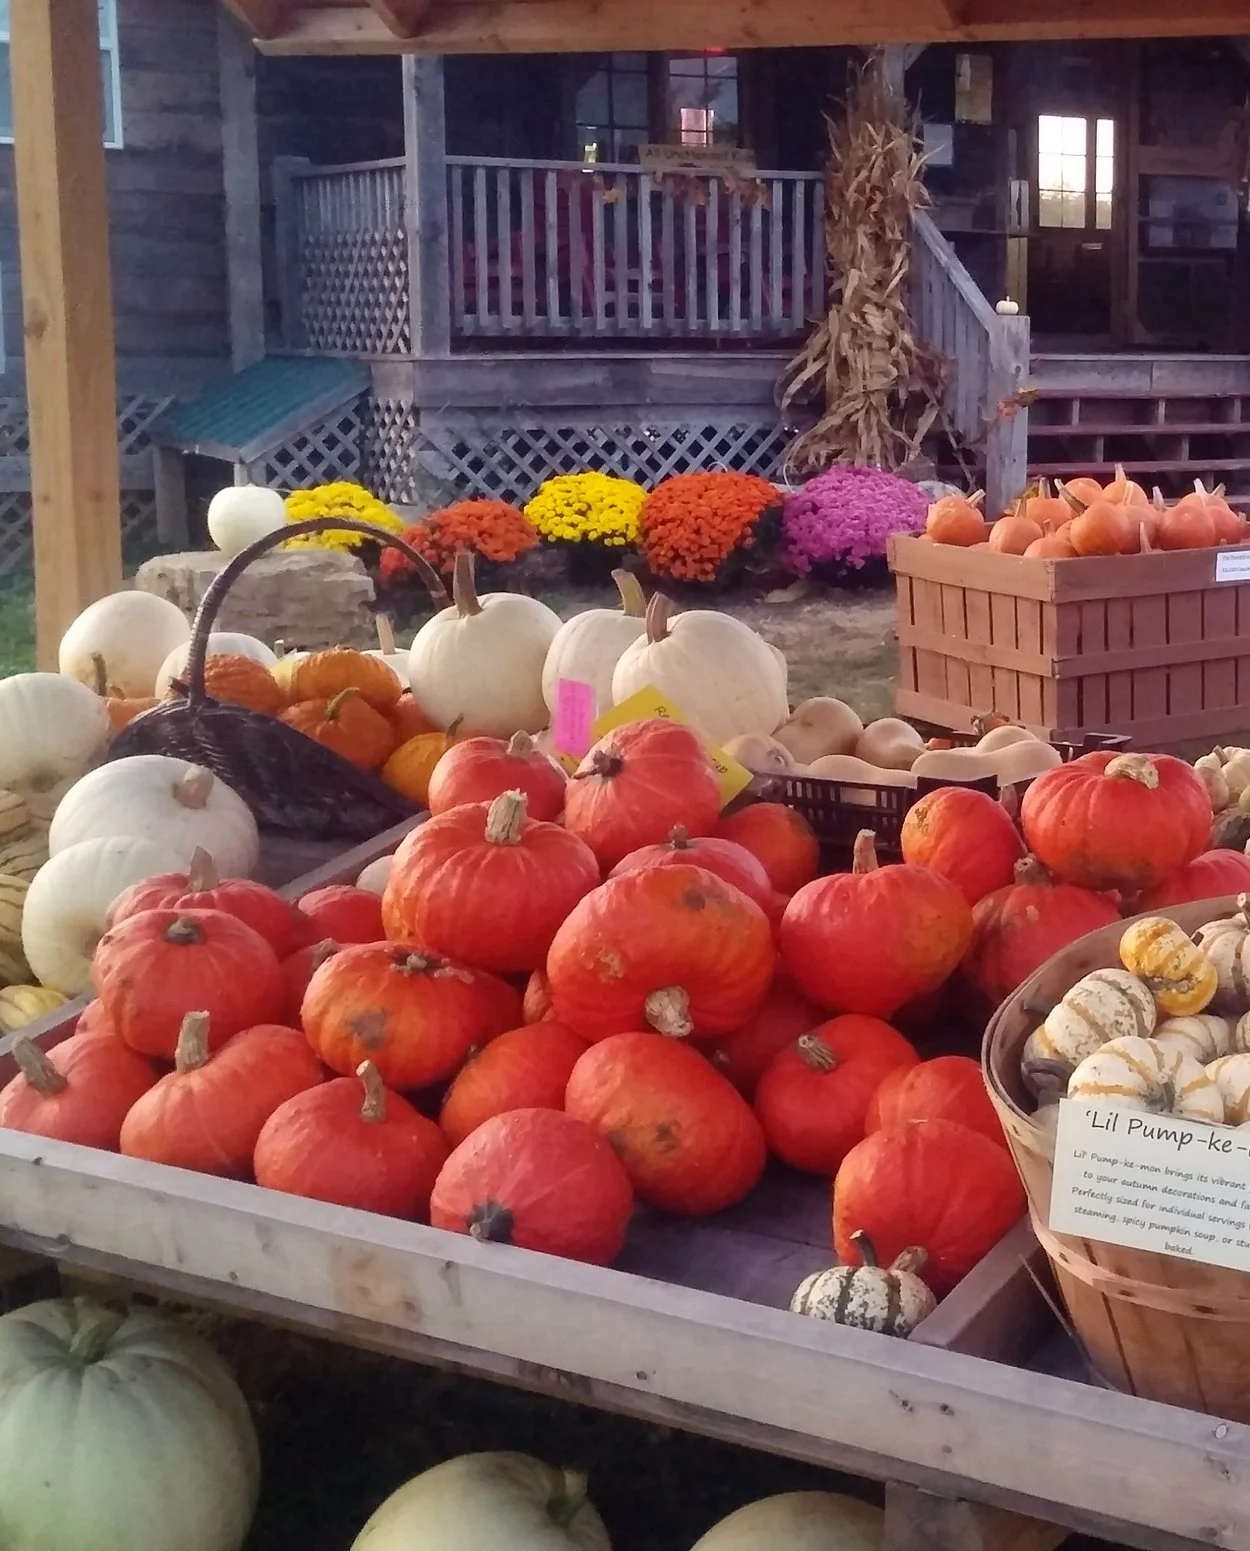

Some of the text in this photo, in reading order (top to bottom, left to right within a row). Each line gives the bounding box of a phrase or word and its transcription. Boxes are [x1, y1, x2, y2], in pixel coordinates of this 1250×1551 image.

[1083, 1171, 1093, 1179] to
[1096, 1174, 1118, 1183] your
[1121, 1178, 1158, 1192] autumn
[1161, 1186, 1215, 1204] decorations
[1218, 1198, 1238, 1208] and
[1091, 1152, 1161, 1173] Pump-ke-mon
[1164, 1166, 1193, 1182] brings
[1196, 1173, 1208, 1183] its
[1211, 1177, 1247, 1190] vibrant
[1071, 1186, 1113, 1204] Perfectly
[1116, 1196, 1139, 1207] sized
[1141, 1199, 1156, 1210] for
[1158, 1205, 1205, 1220] individual
[1208, 1214, 1245, 1230] servings
[1122, 1215, 1146, 1229] spicy
[1148, 1221, 1191, 1236] pumpkin
[1222, 1236, 1233, 1244] or
